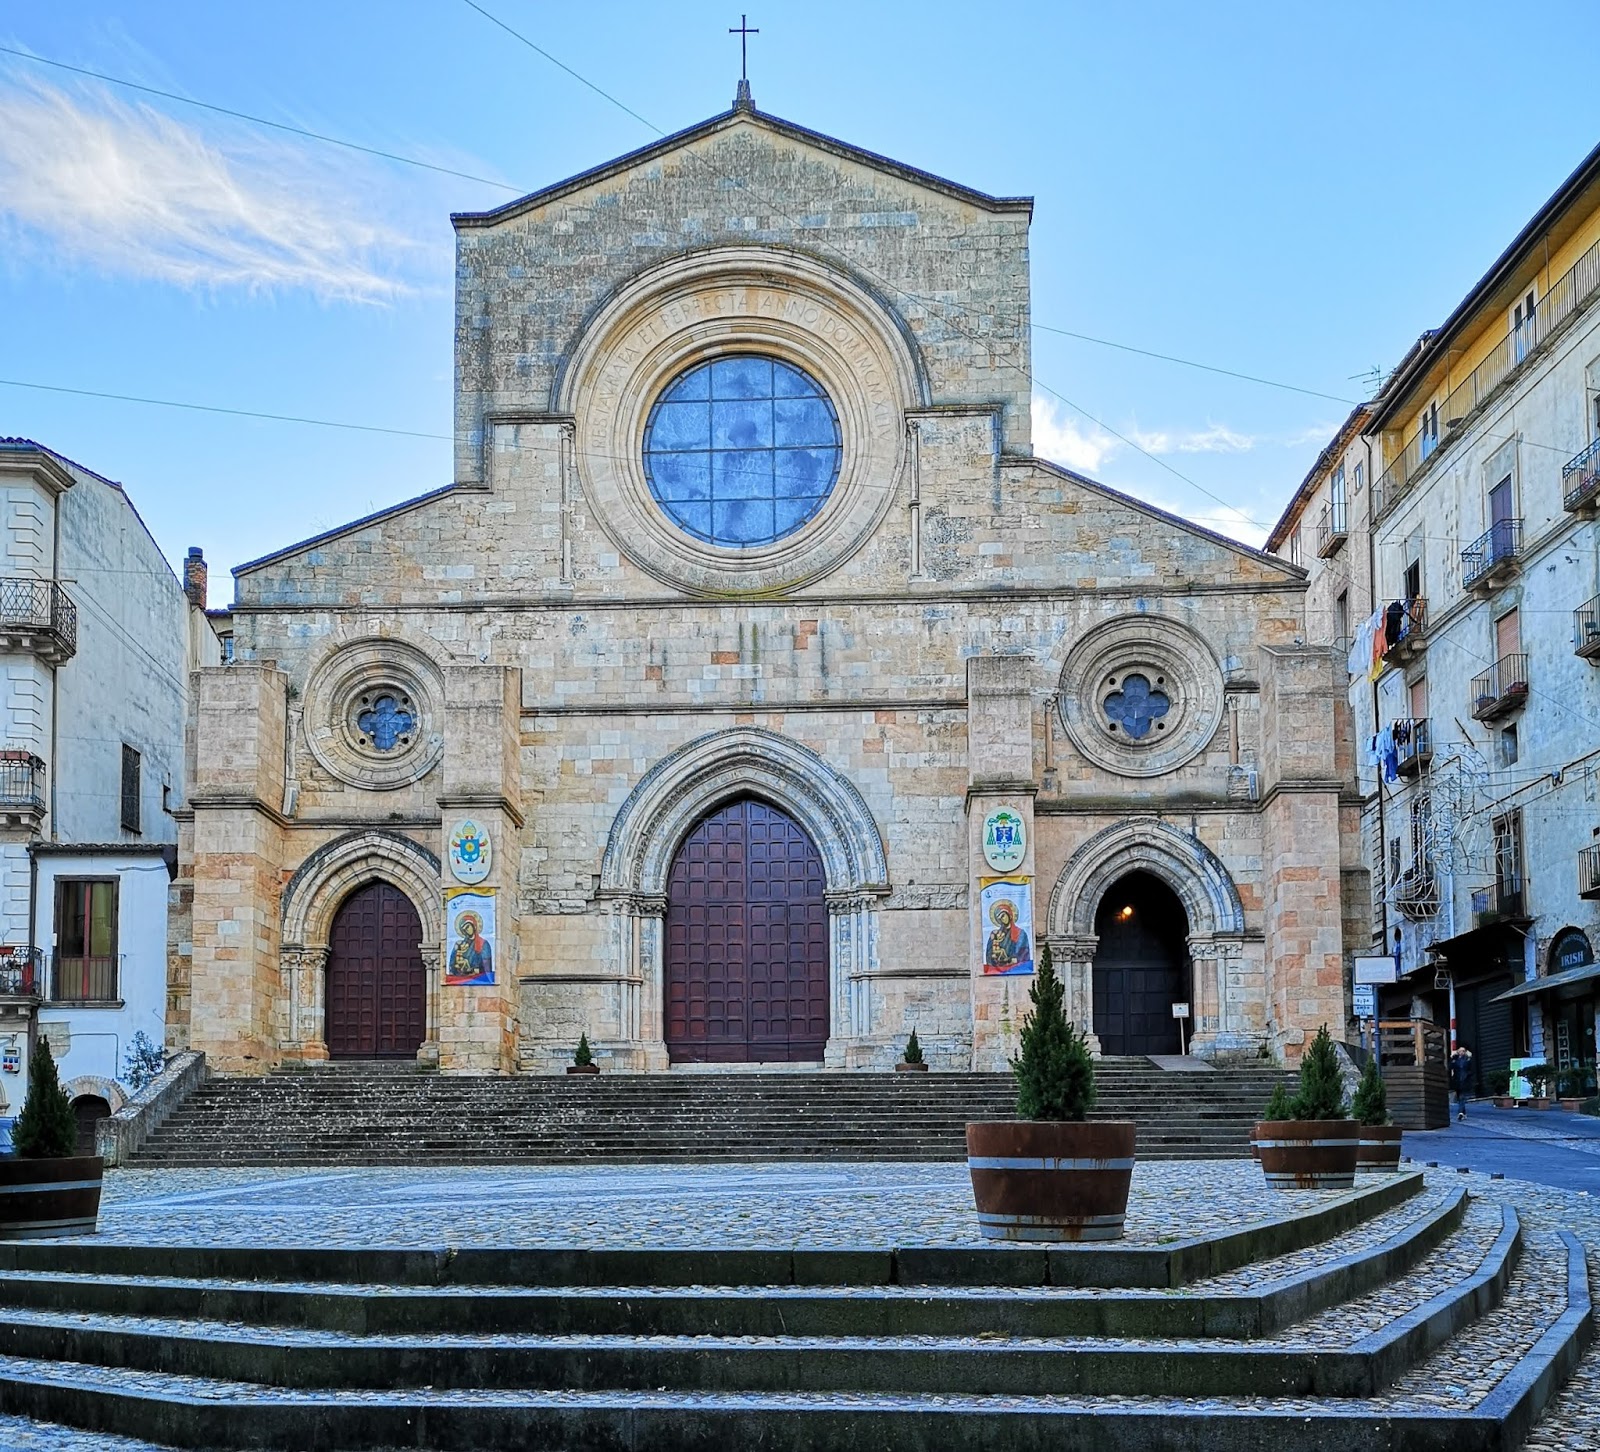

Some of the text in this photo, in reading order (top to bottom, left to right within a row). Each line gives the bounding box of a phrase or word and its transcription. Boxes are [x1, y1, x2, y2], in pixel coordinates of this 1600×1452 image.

[637, 322, 659, 346] ET
[659, 292, 748, 330] PERFECTA
[761, 295, 819, 324] ANNO
[1561, 950, 1584, 967] IRISH
